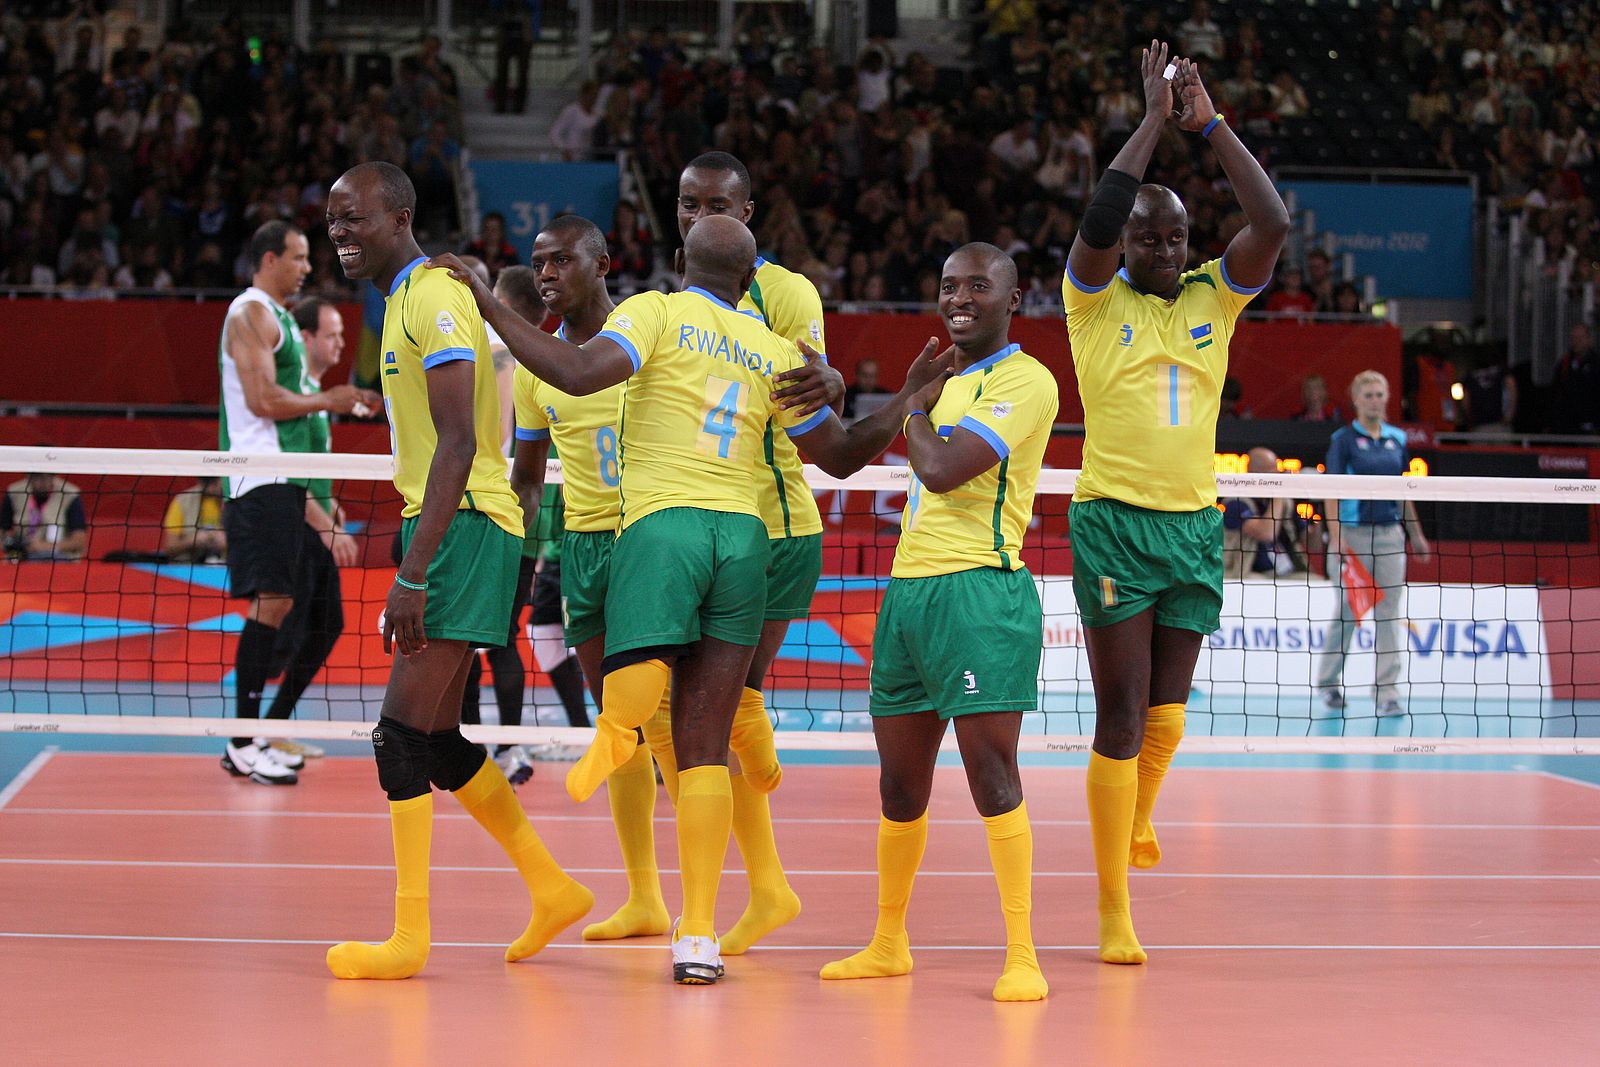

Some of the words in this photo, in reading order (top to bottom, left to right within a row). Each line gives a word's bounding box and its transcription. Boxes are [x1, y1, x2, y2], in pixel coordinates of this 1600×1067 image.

[511, 202, 549, 235] 31
[1169, 365, 1179, 426] 1
[703, 382, 743, 458] 4
[202, 456, 230, 464] London
[231, 456, 249, 464] 2012
[596, 426, 620, 487] 8
[890, 471, 909, 479] Lond
[1216, 478, 1257, 486] Paralympic
[1258, 479, 1283, 487] Games
[1554, 484, 1580, 492] London
[1210, 626, 1373, 649] SAMSUG
[1402, 620, 1527, 659] VISA
[1046, 743, 1088, 751] Paralympic
[1393, 745, 1419, 753] London
